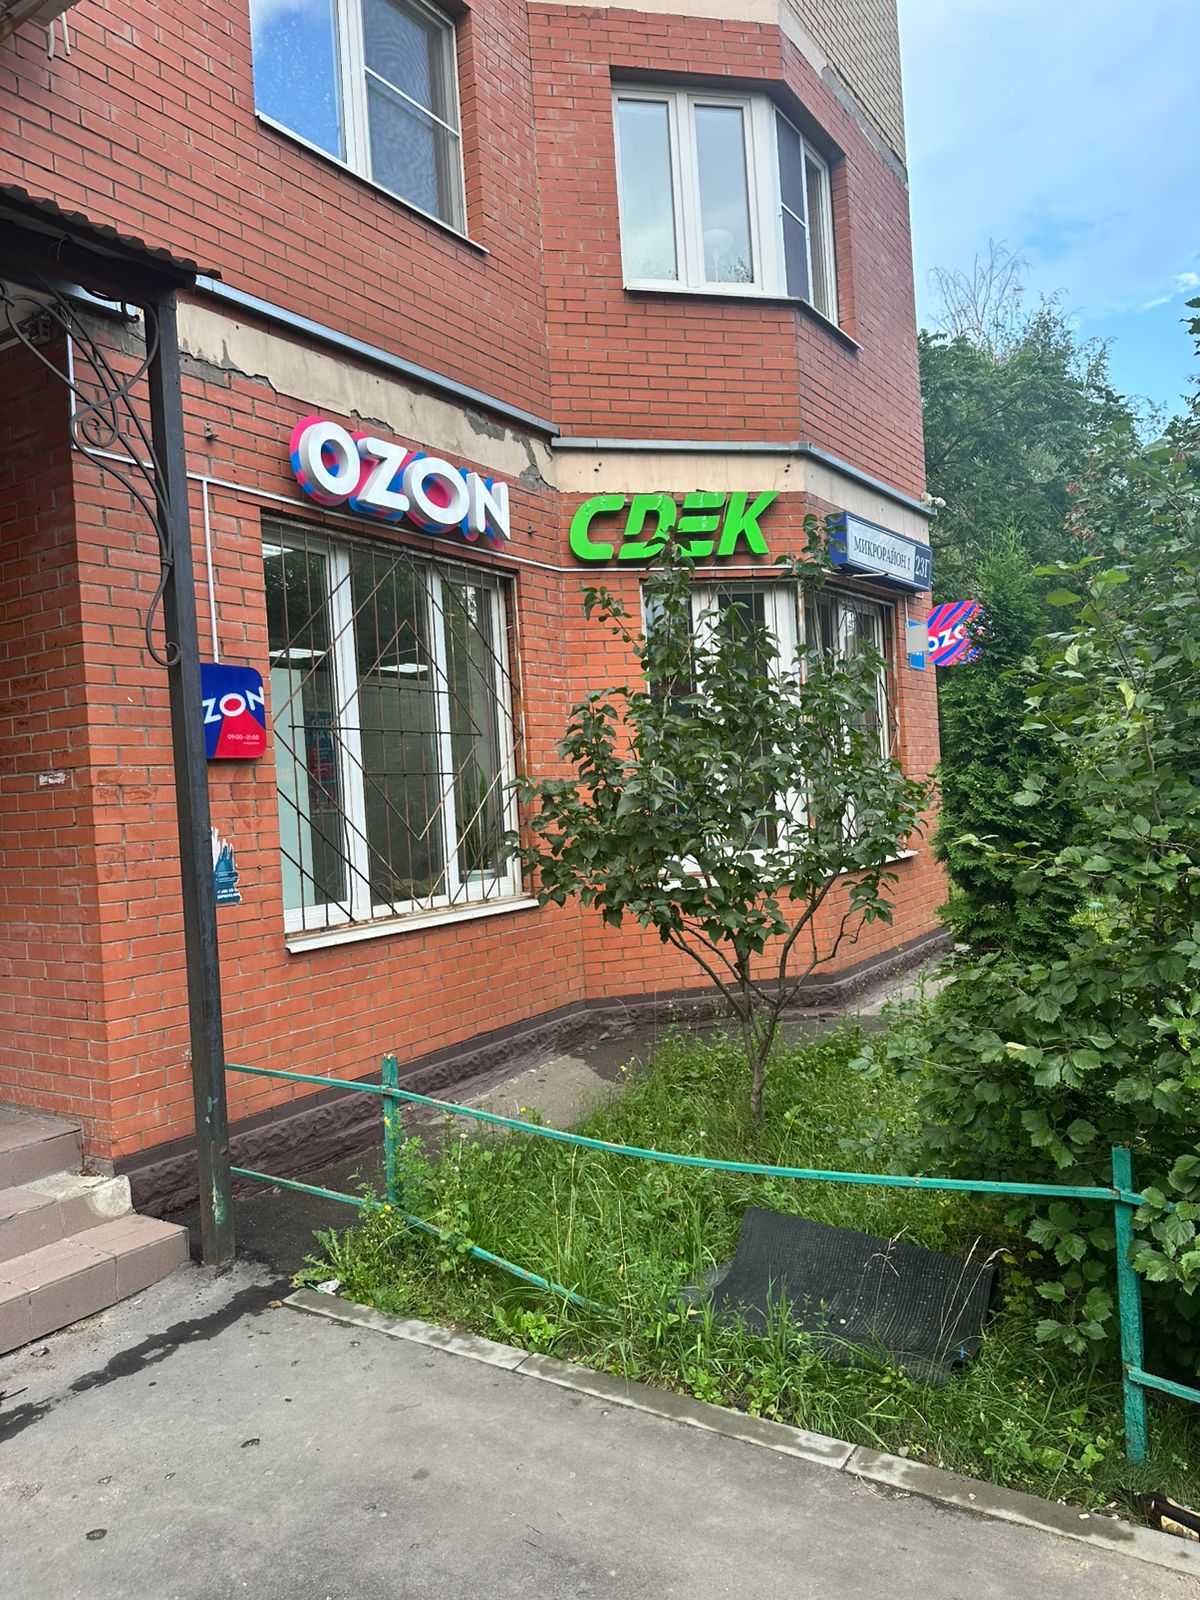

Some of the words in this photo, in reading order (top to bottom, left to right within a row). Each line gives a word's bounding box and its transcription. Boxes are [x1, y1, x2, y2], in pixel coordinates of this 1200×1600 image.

[296, 419, 510, 541] OZON
[569, 491, 780, 560] CDEK
[854, 536, 906, 569] МИКРОРАЙОН
[907, 557, 911, 571] 1
[915, 555, 930, 578] 23Г
[202, 686, 264, 724] ZON
